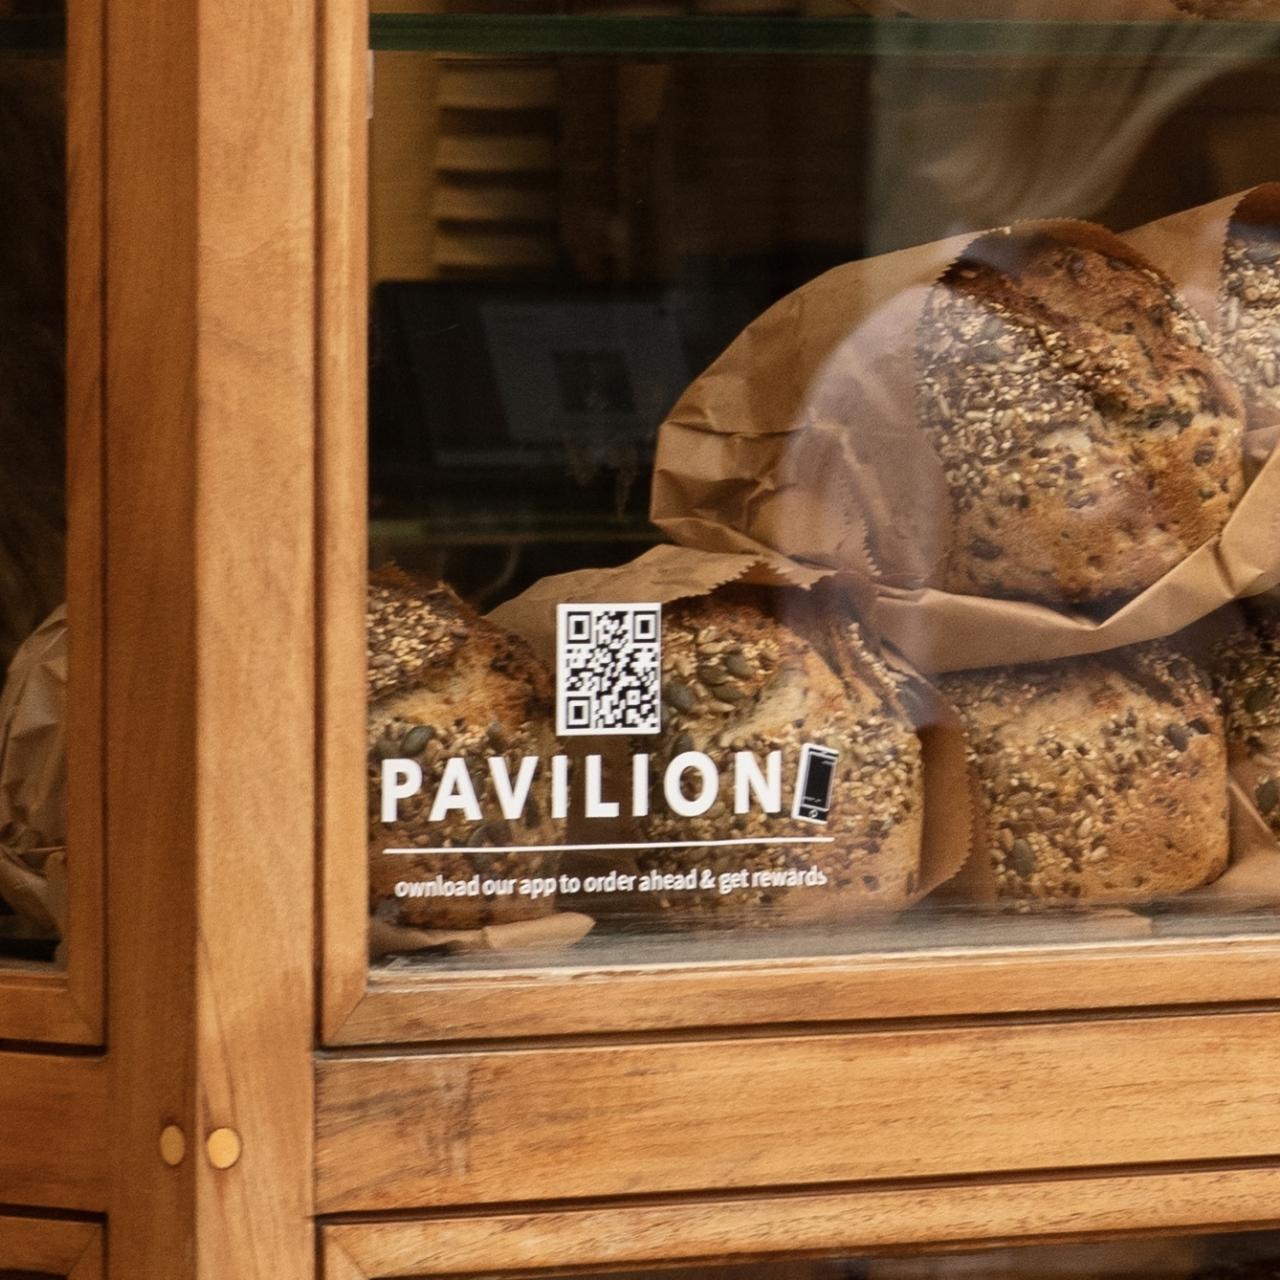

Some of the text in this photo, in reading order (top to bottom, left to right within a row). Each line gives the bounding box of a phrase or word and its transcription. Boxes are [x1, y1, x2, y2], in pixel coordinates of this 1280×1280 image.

[380, 750, 782, 823] PAVILION
[481, 877, 518, 896] our
[518, 876, 557, 900] app
[559, 873, 581, 894] to
[583, 870, 636, 893] order
[638, 868, 698, 892] ahead
[699, 869, 716, 889] &
[718, 868, 750, 895] get
[751, 865, 828, 888] rewards
